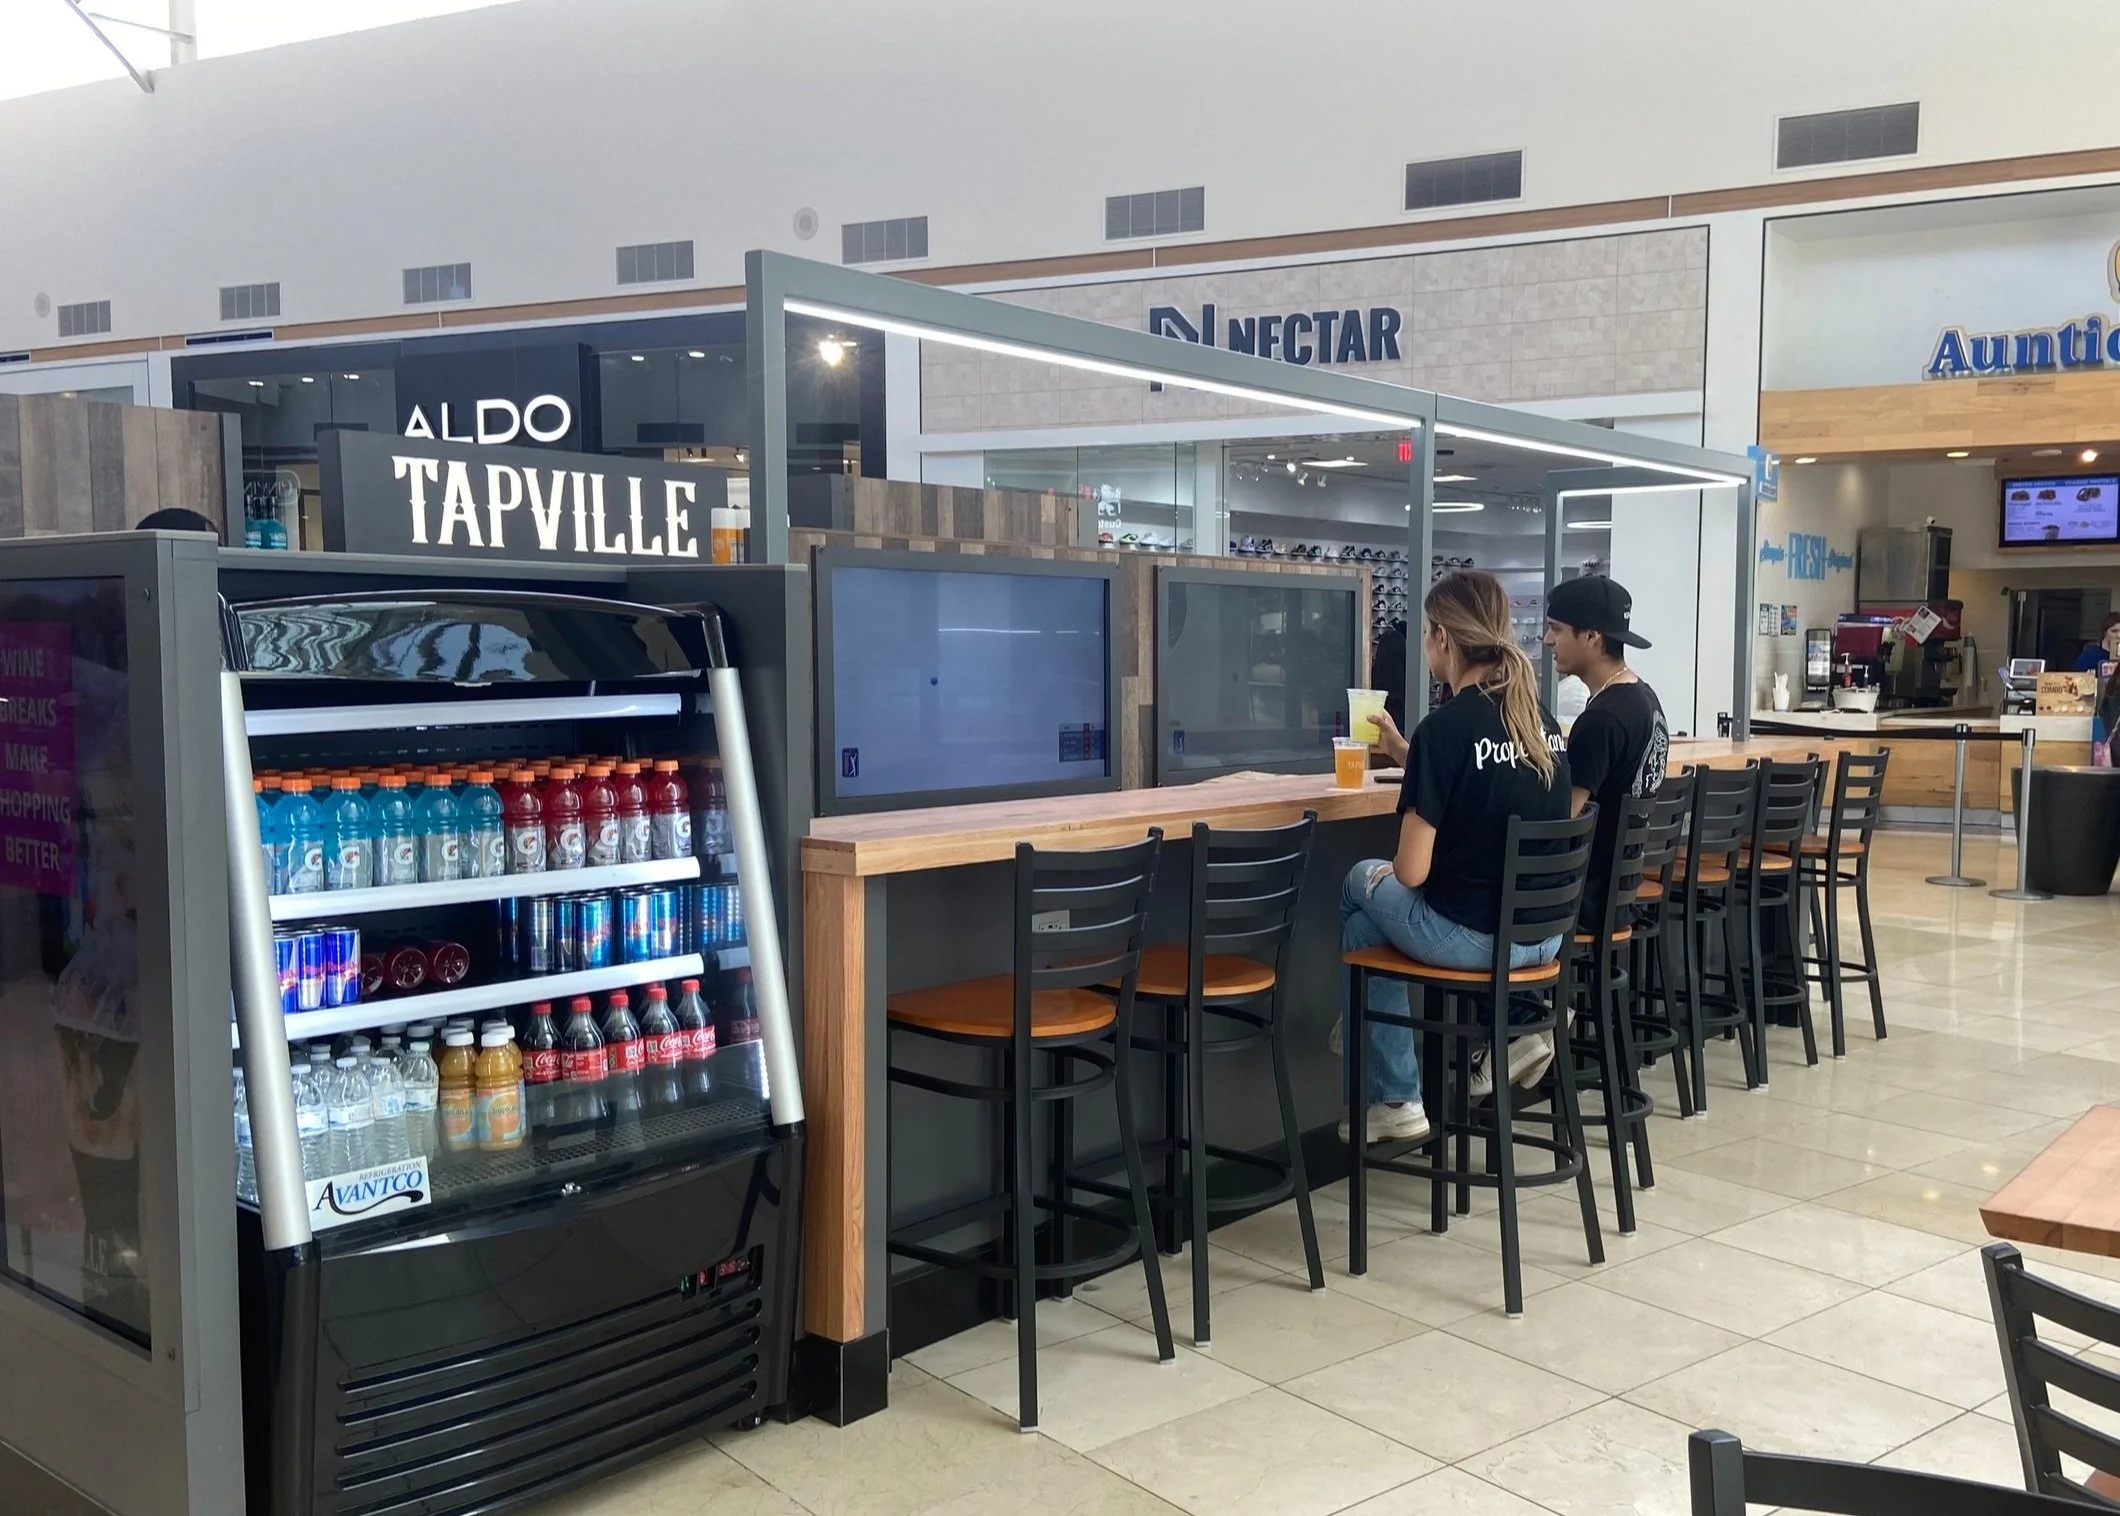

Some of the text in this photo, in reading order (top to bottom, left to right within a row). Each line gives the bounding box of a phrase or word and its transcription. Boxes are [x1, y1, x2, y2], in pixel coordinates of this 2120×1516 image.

[1228, 307, 1401, 365] NECTAR
[404, 394, 571, 444] ALDO
[391, 455, 699, 558] TAPVILLE
[3, 648, 45, 678] WINE
[5, 746, 49, 774] MAKE
[0, 788, 71, 824] HOPPING
[5, 835, 60, 871] BETTER
[359, 1160, 421, 1180] REFRIGERATION
[312, 1170, 423, 1213] AVANTCO
